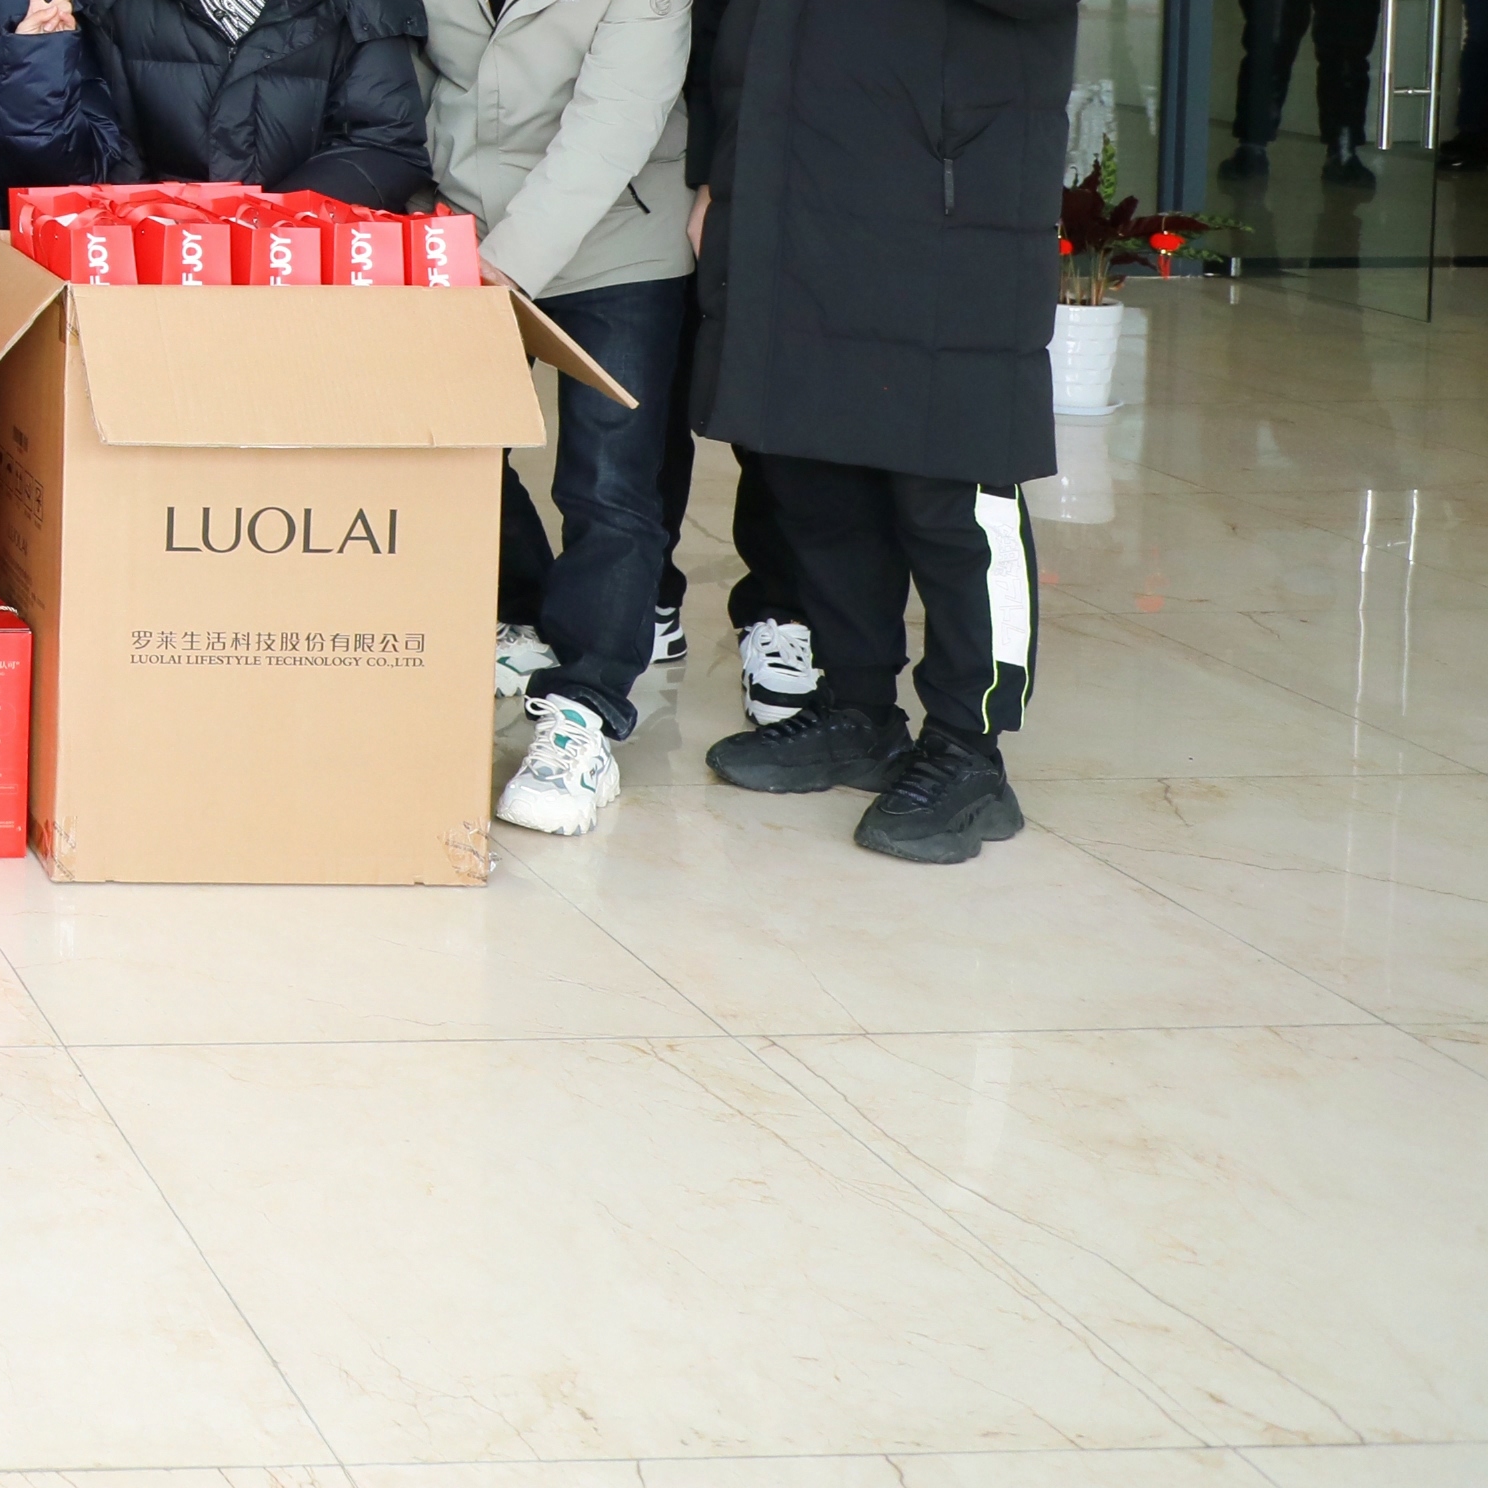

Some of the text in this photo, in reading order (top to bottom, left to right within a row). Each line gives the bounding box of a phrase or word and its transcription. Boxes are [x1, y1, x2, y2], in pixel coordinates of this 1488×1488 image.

[87, 233, 109, 274] JOY
[182, 229, 203, 272] JOY
[270, 233, 292, 275] JOY
[351, 228, 373, 270] JOY
[424, 225, 448, 266] JOY
[166, 506, 399, 555] LUOLAI
[130, 654, 425, 668] LUOLAI LIFESTYLE TECHNOLOGY CO.,LTD.
[131, 630, 425, 653] 罗莱生活科技股份有限公司
